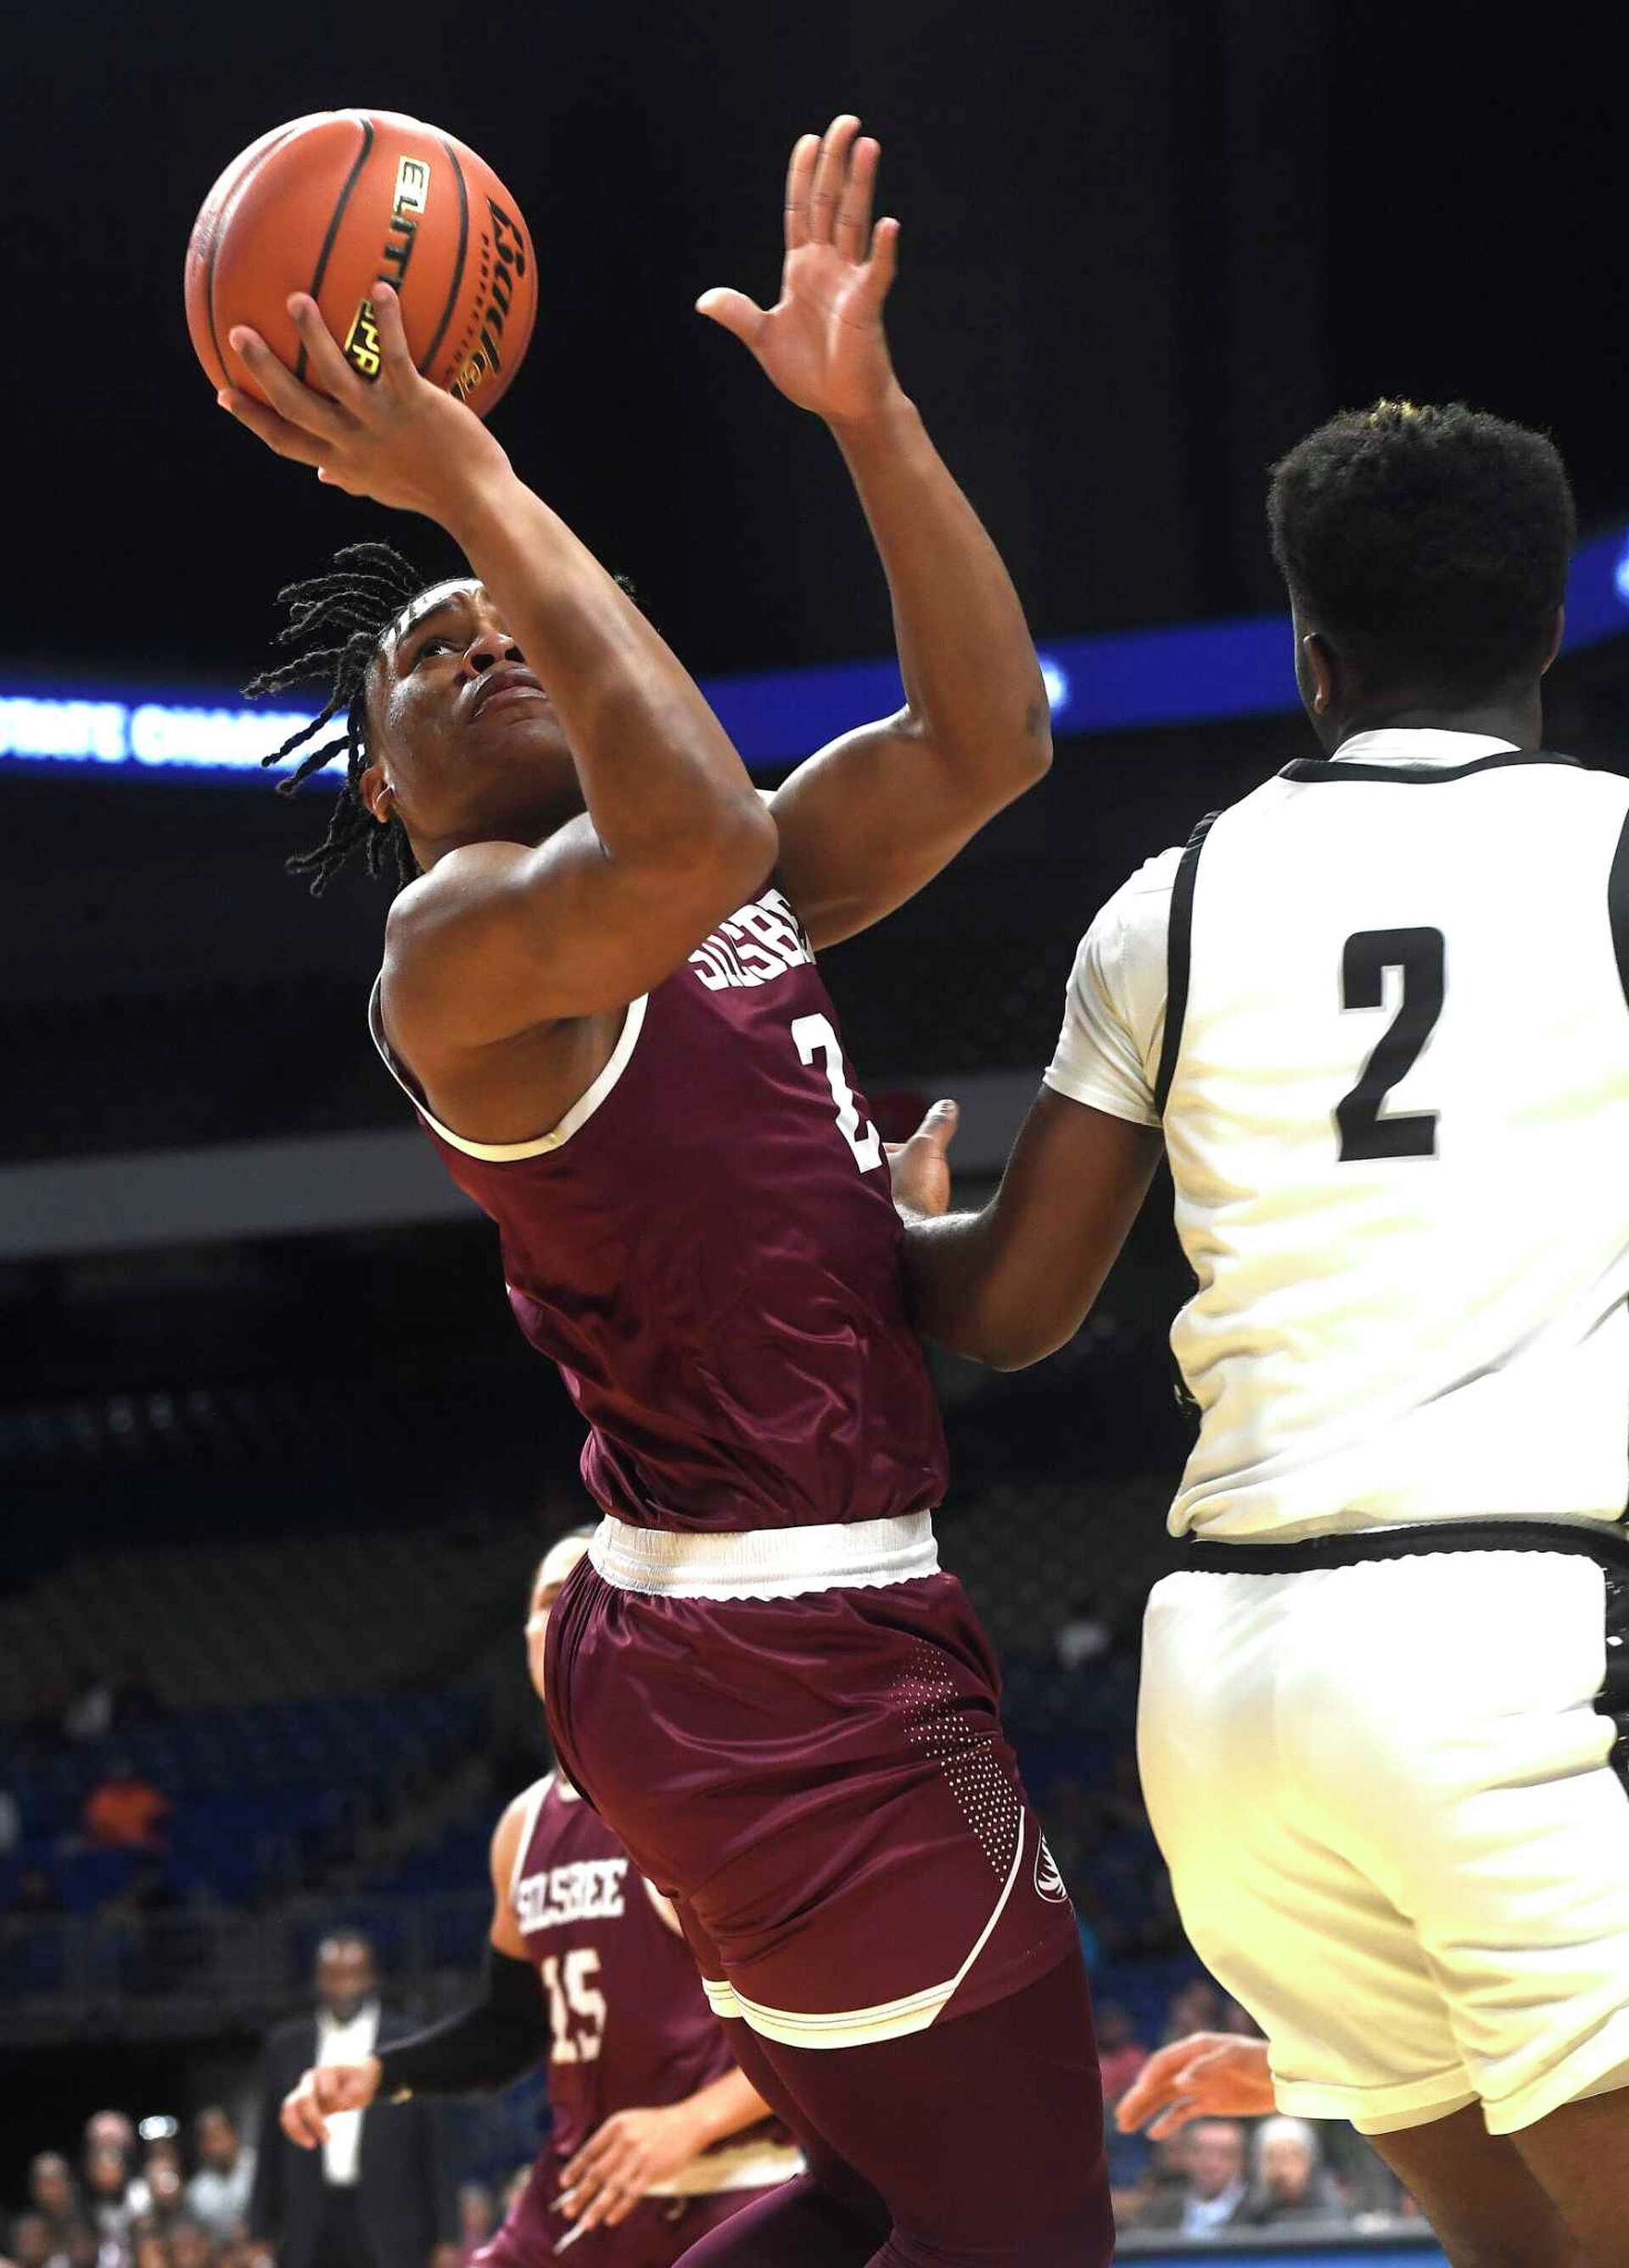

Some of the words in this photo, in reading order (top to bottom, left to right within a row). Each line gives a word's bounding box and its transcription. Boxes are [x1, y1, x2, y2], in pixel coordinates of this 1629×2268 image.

[687, 888, 816, 991] SILSBE
[791, 1013, 882, 1173] 2
[1332, 925, 1447, 1163] 2
[516, 1856, 630, 1935] SILSBEE
[540, 1947, 607, 2065] 15
